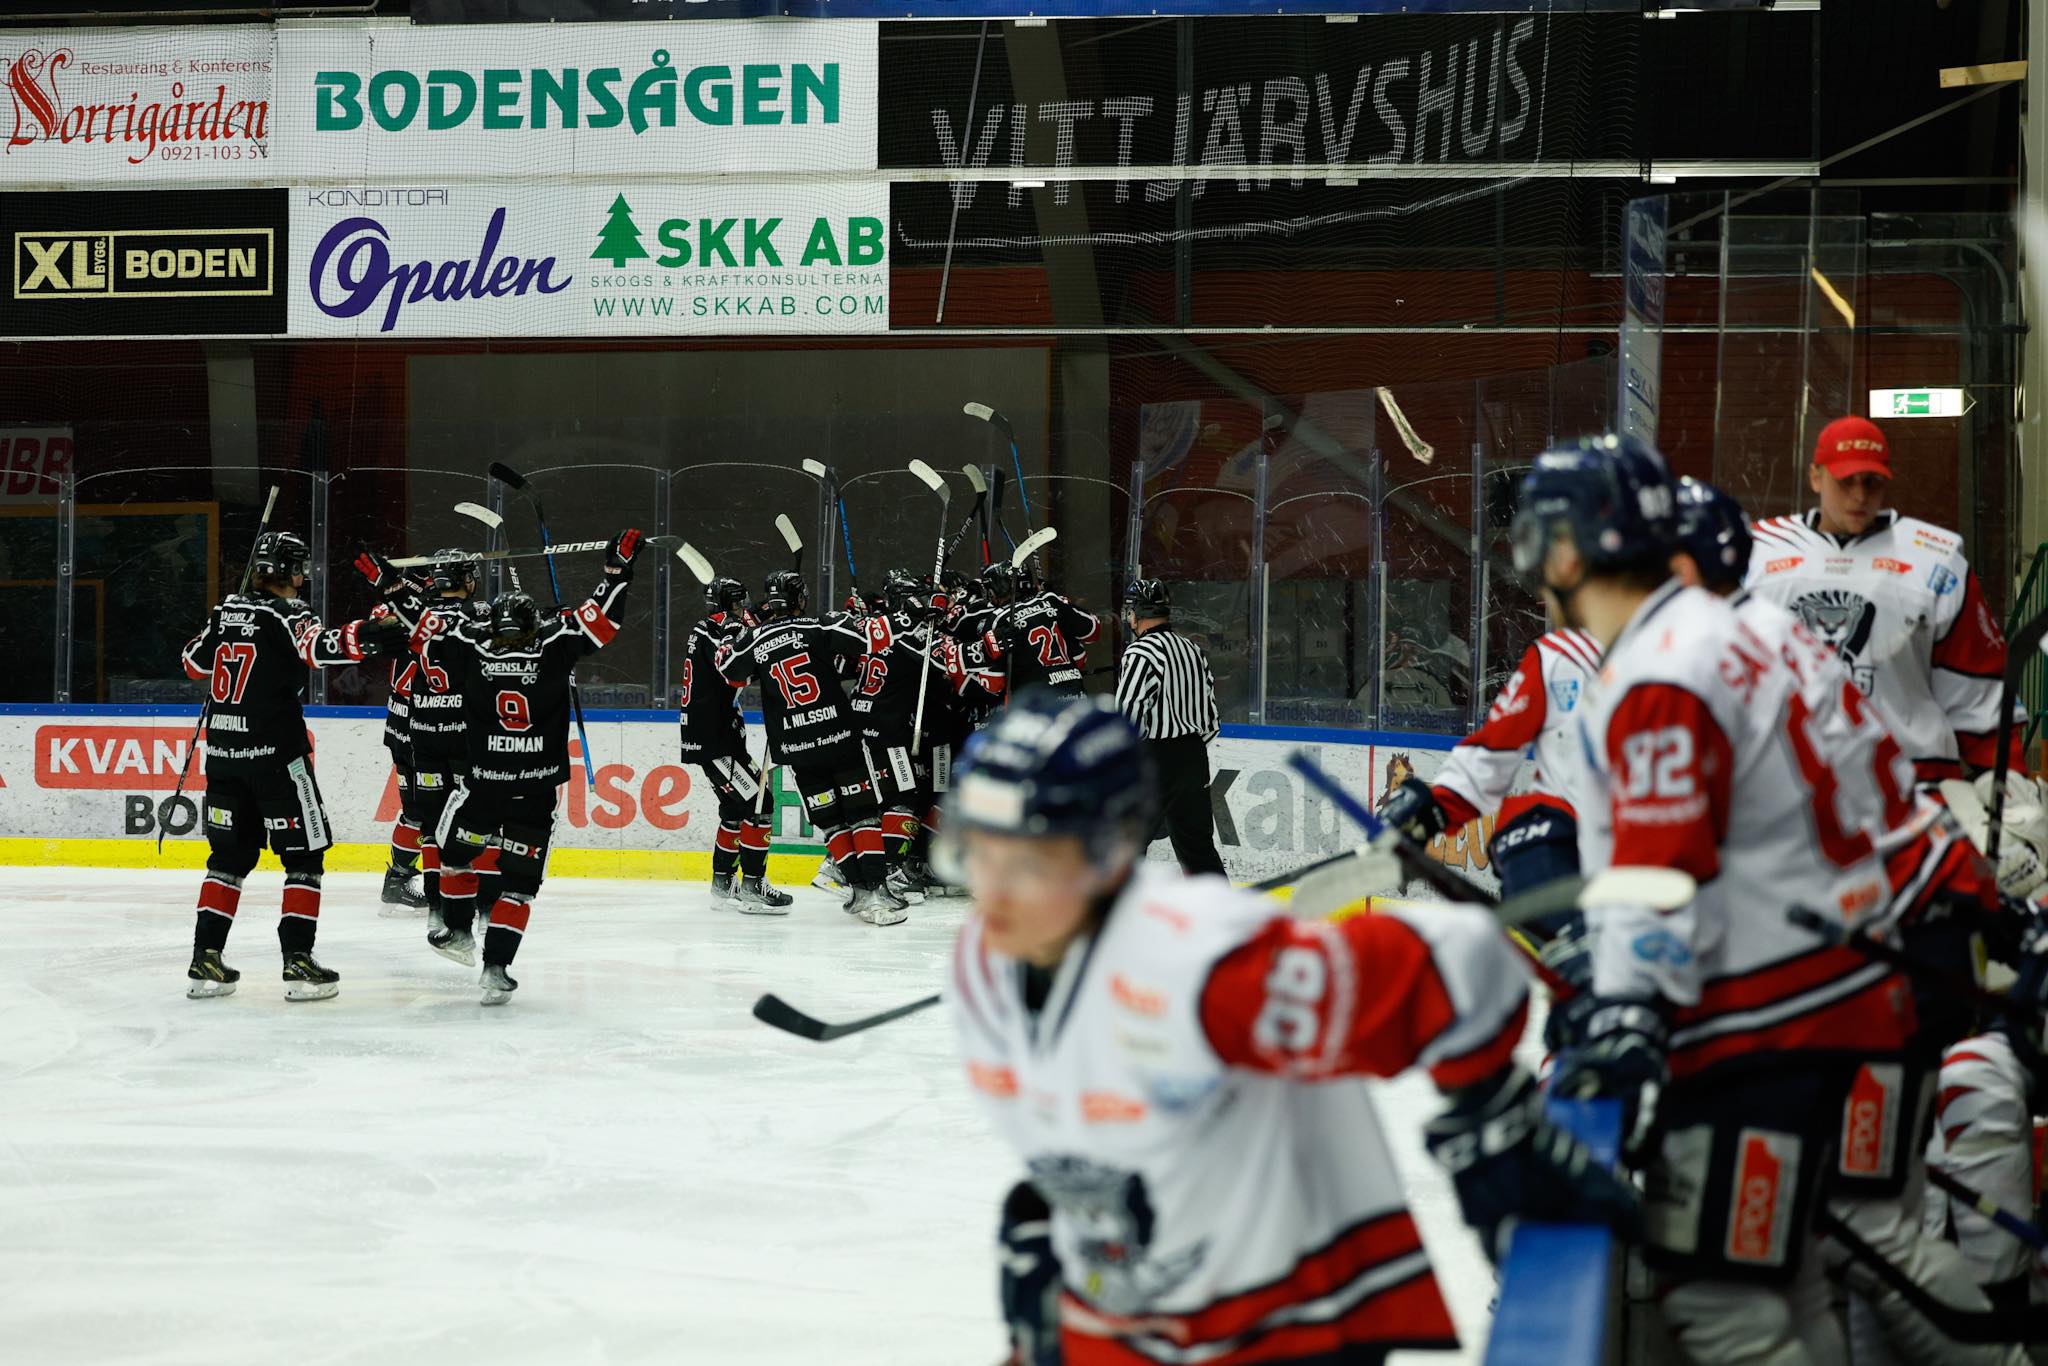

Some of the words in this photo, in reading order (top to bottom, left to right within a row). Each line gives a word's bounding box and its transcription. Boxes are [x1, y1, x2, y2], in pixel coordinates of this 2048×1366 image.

[82, 60, 167, 76] Restaurang
[172, 60, 182, 75] &
[189, 58, 270, 74] Konferens
[0, 47, 269, 164] Norrigården
[315, 49, 840, 135] BODENSÅGEN
[161, 145, 241, 160] 0921-103
[308, 188, 448, 207] KONDITORI
[656, 217, 783, 268] SKK
[799, 216, 885, 266] AB
[21, 241, 105, 289] XL
[126, 247, 256, 279] BODEN
[309, 207, 573, 332] Opalen
[591, 274, 653, 288] SKOGS
[663, 274, 673, 287] &
[682, 272, 884, 288] KRAFTKONSULTERNA
[594, 295, 885, 318] WWW.SKKAB.COM
[933, 537, 944, 585] BAUER
[1028, 621, 1071, 667] 21
[211, 642, 258, 704] 67
[769, 651, 821, 710] 15
[496, 690, 532, 731] 9
[784, 717, 793, 730] A.
[796, 705, 838, 728] NILSSON
[50, 737, 207, 775] KVANT
[487, 736, 544, 753] HEDMAN
[125, 795, 207, 836] BO
[309, 810, 321, 839] BOARD
